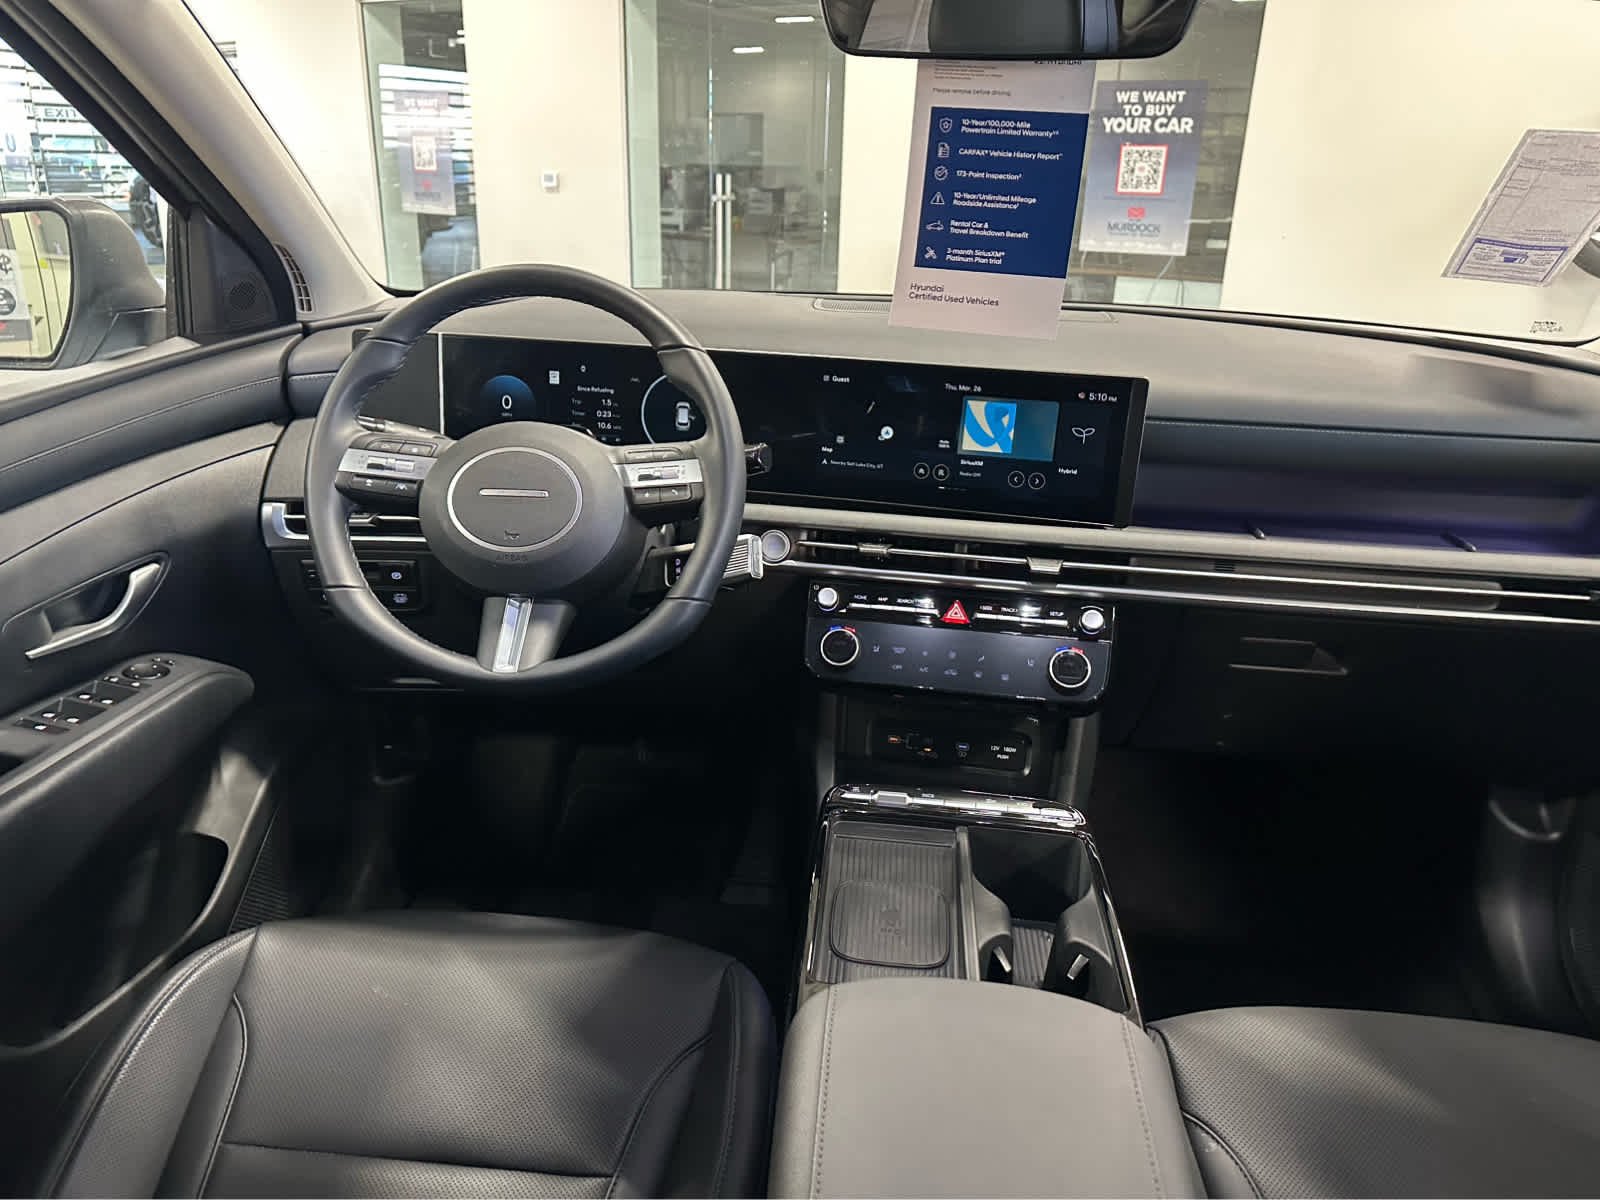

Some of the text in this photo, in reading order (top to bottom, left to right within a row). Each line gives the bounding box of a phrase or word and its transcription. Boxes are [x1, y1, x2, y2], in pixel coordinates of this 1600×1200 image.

[1116, 90, 1186, 103] WE WANT
[1123, 104, 1176, 116] TO BUY
[1102, 117, 1194, 134] YOUR CAR
[960, 127, 996, 135] Powertrain
[997, 128, 1021, 136] Limited
[989, 150, 1012, 158] Vehicle
[1013, 151, 1036, 160] History
[953, 199, 983, 207] Roadside
[1010, 195, 1037, 204] Mileage
[950, 219, 971, 227] Rental
[1107, 221, 1161, 233] MURDOCK
[969, 228, 1005, 237] Breakdown
[1005, 230, 1029, 239] Benefit
[945, 254, 1002, 265] Platinum Plan trial
[910, 282, 945, 293] Hyundai
[908, 291, 1000, 307] Certified Used Vehicles
[832, 375, 850, 383] Guest
[501, 394, 512, 409] 0
[1089, 392, 1108, 401] 5:10
[1058, 467, 1078, 475] Hybrid
